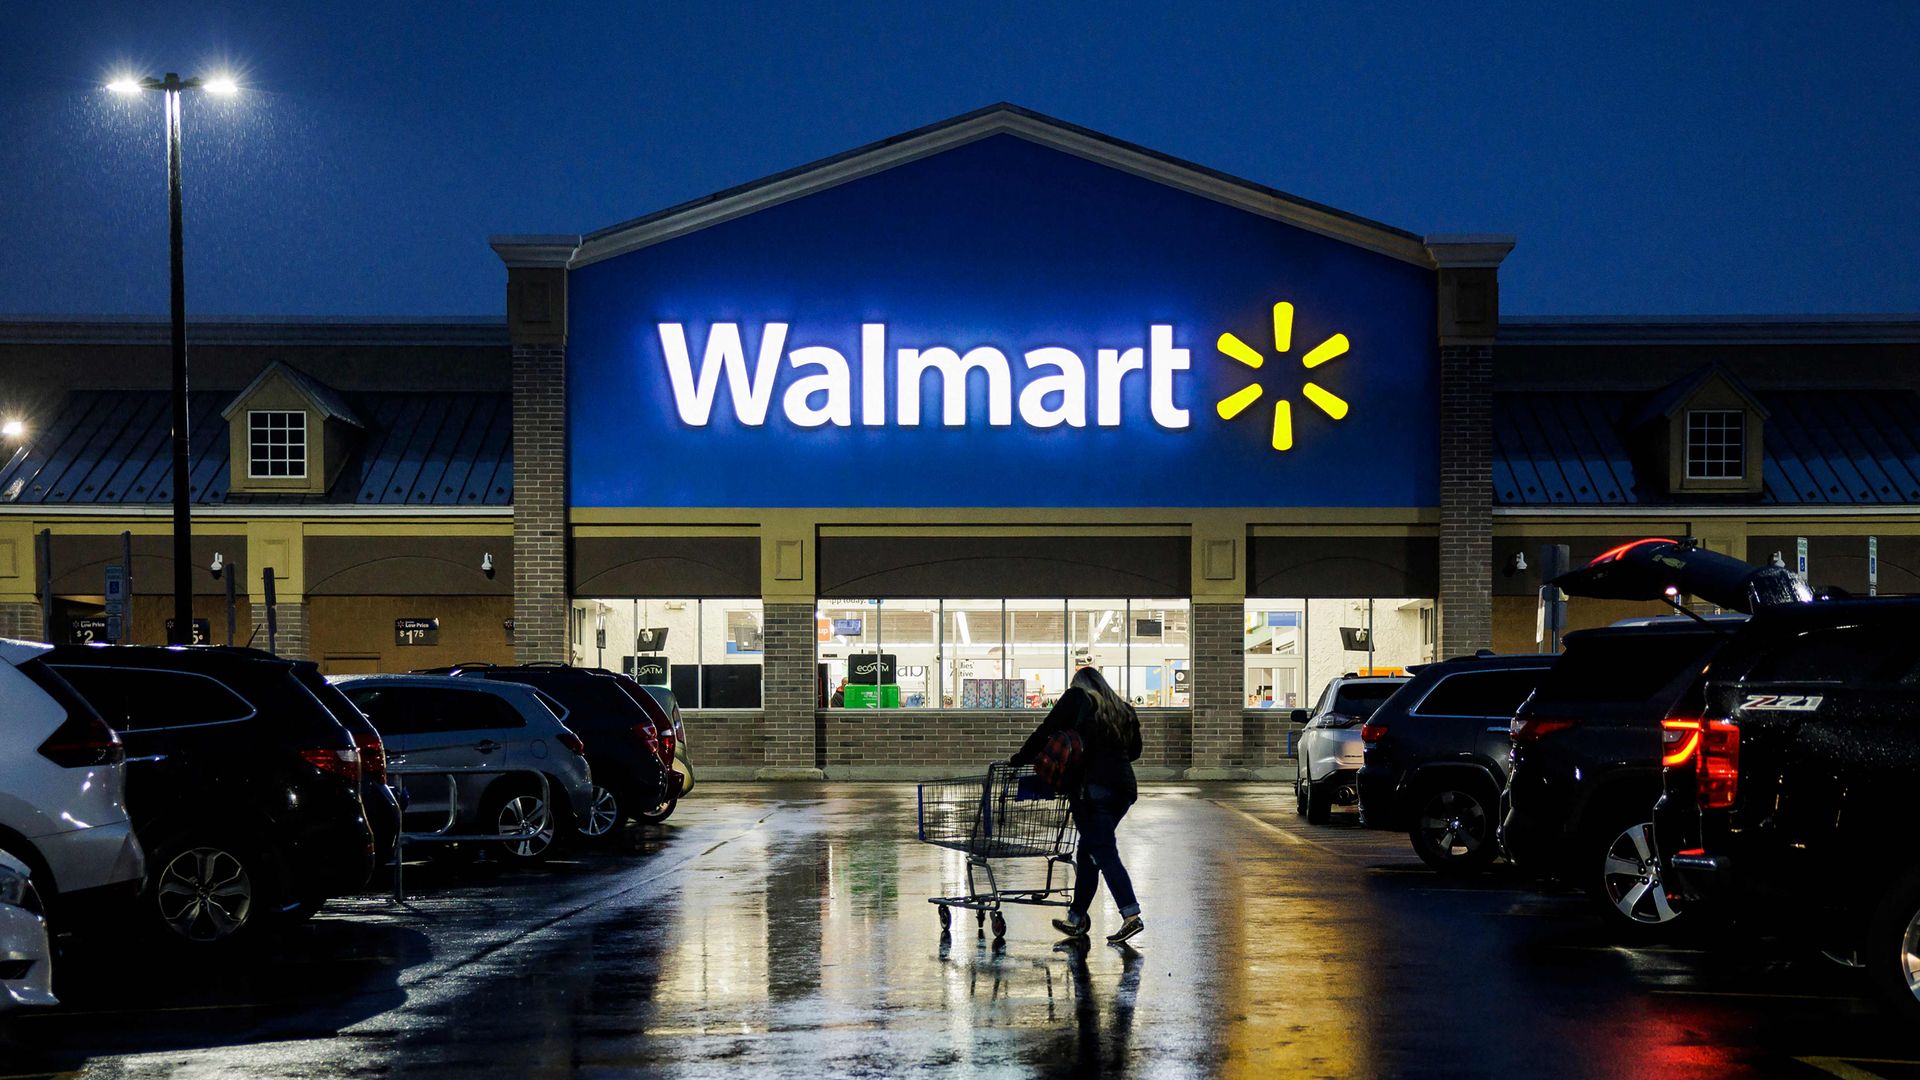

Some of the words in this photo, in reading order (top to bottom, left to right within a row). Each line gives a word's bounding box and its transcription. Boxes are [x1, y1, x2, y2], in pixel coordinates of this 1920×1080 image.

[658, 322, 1190, 428] Walmart
[856, 663, 889, 673] ecoAM
[1739, 694, 1823, 711] Z71
